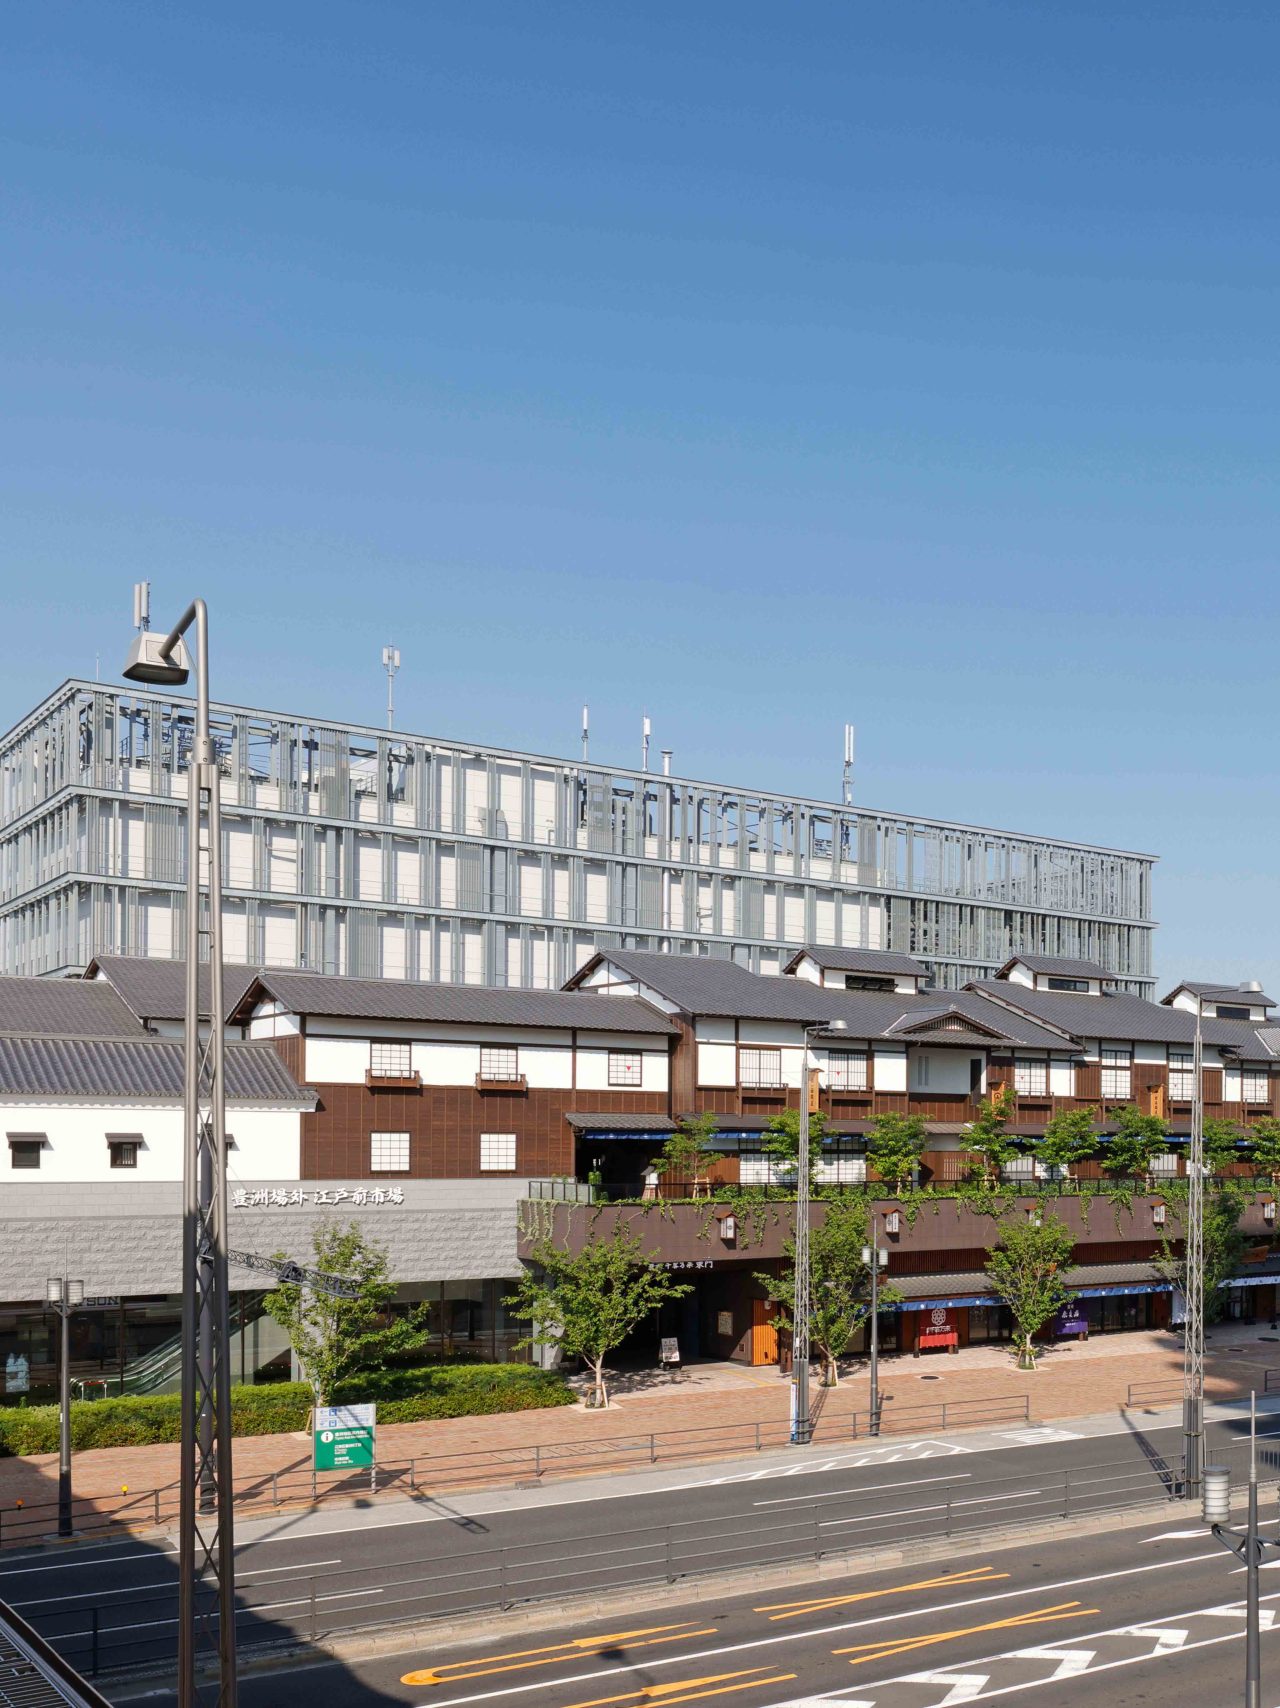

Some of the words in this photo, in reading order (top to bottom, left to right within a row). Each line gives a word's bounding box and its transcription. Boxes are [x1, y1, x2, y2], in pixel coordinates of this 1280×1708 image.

[231, 1188, 308, 1207] 豊洲場外
[314, 1187, 404, 1206] 江戸前市場
